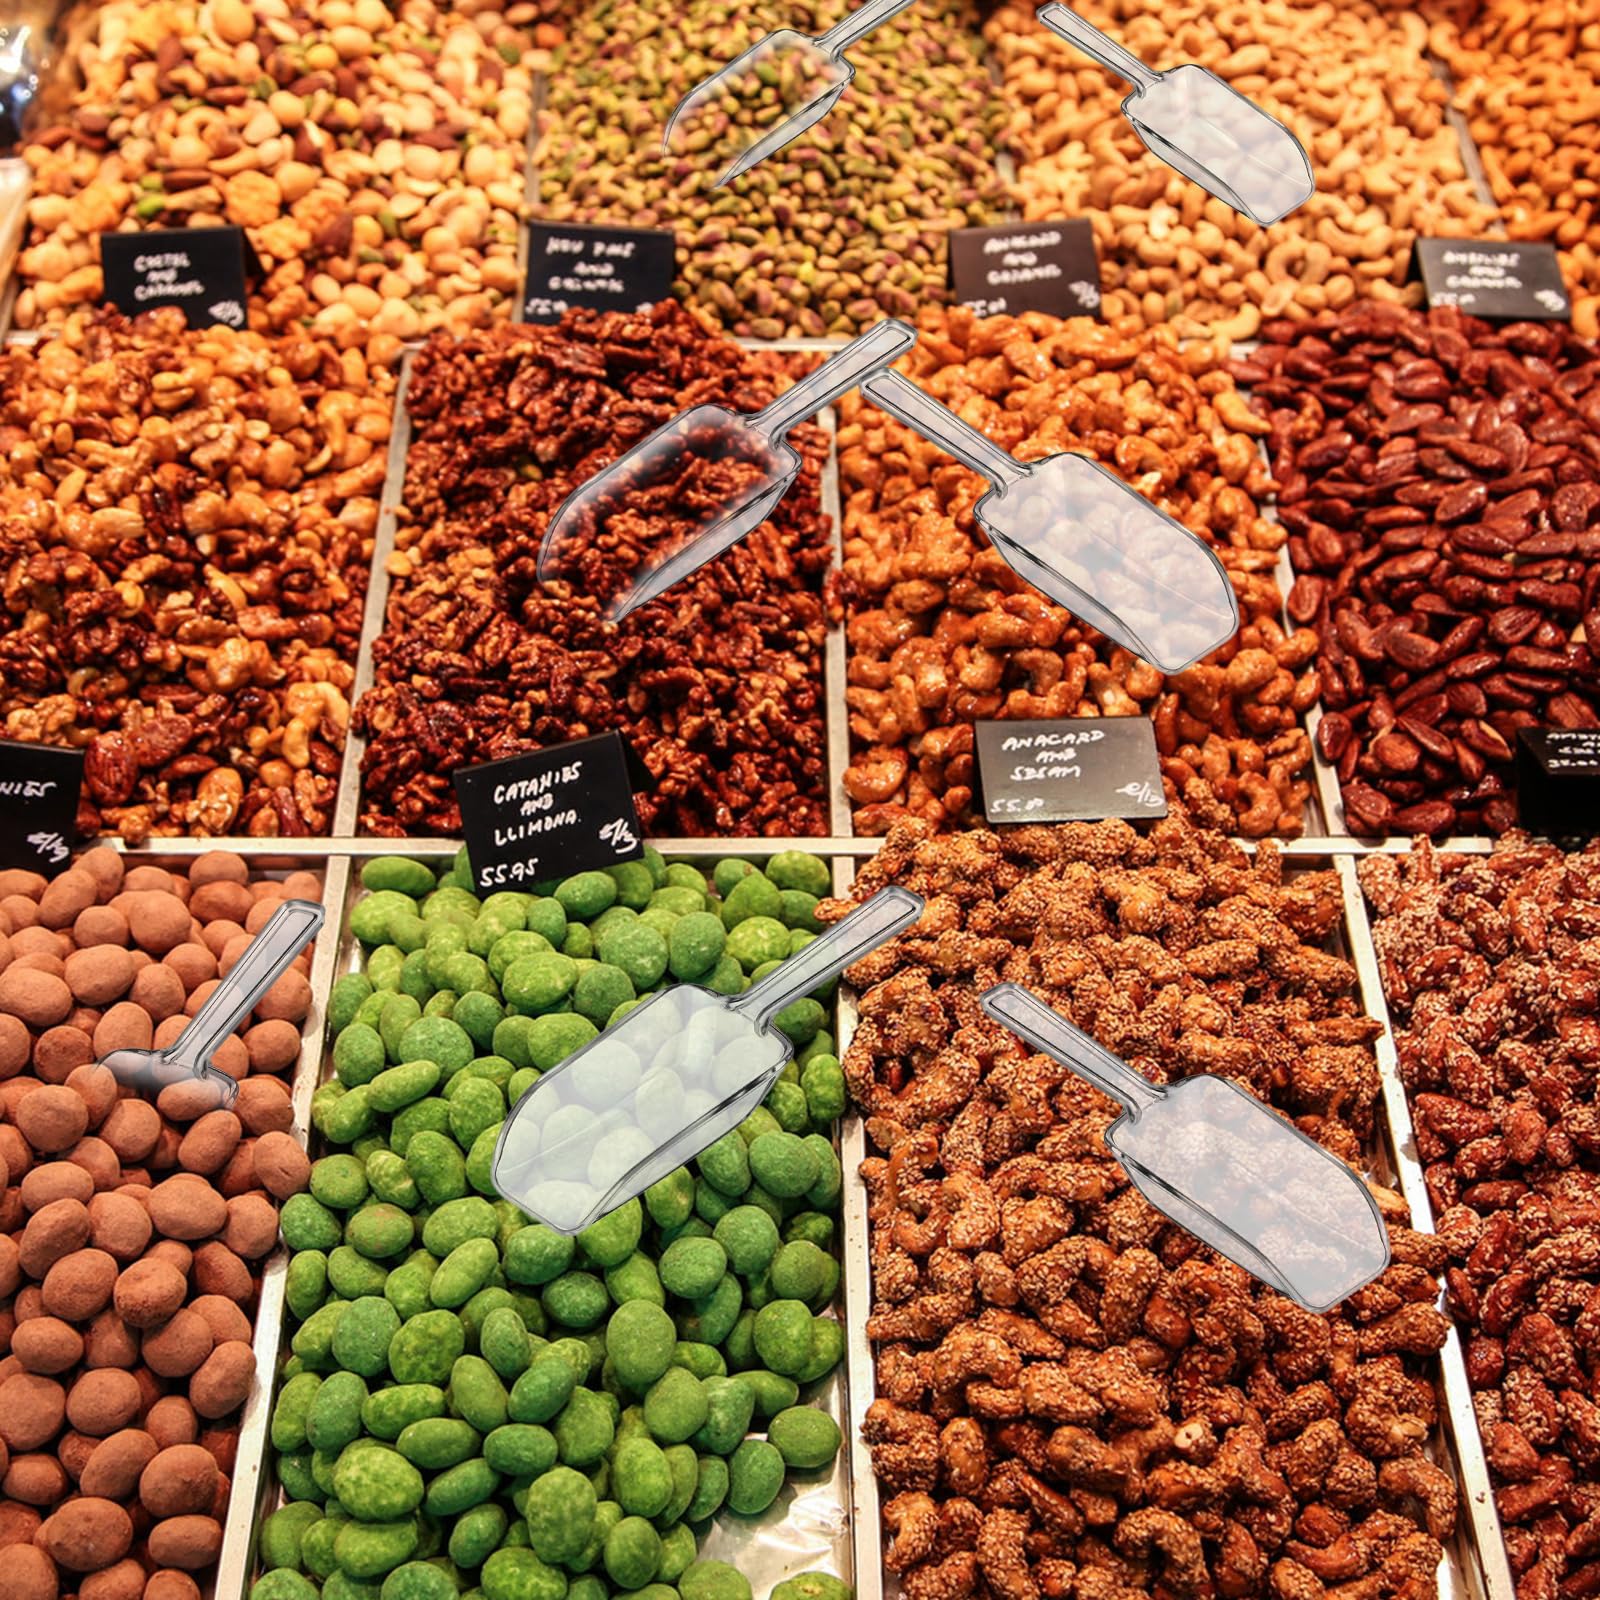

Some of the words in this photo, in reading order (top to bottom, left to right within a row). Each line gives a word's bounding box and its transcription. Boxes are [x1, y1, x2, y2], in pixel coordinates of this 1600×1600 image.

[1001, 730, 1105, 751] ANACARD
[493, 760, 583, 804] CATANIES
[479, 857, 539, 888] 55.95
